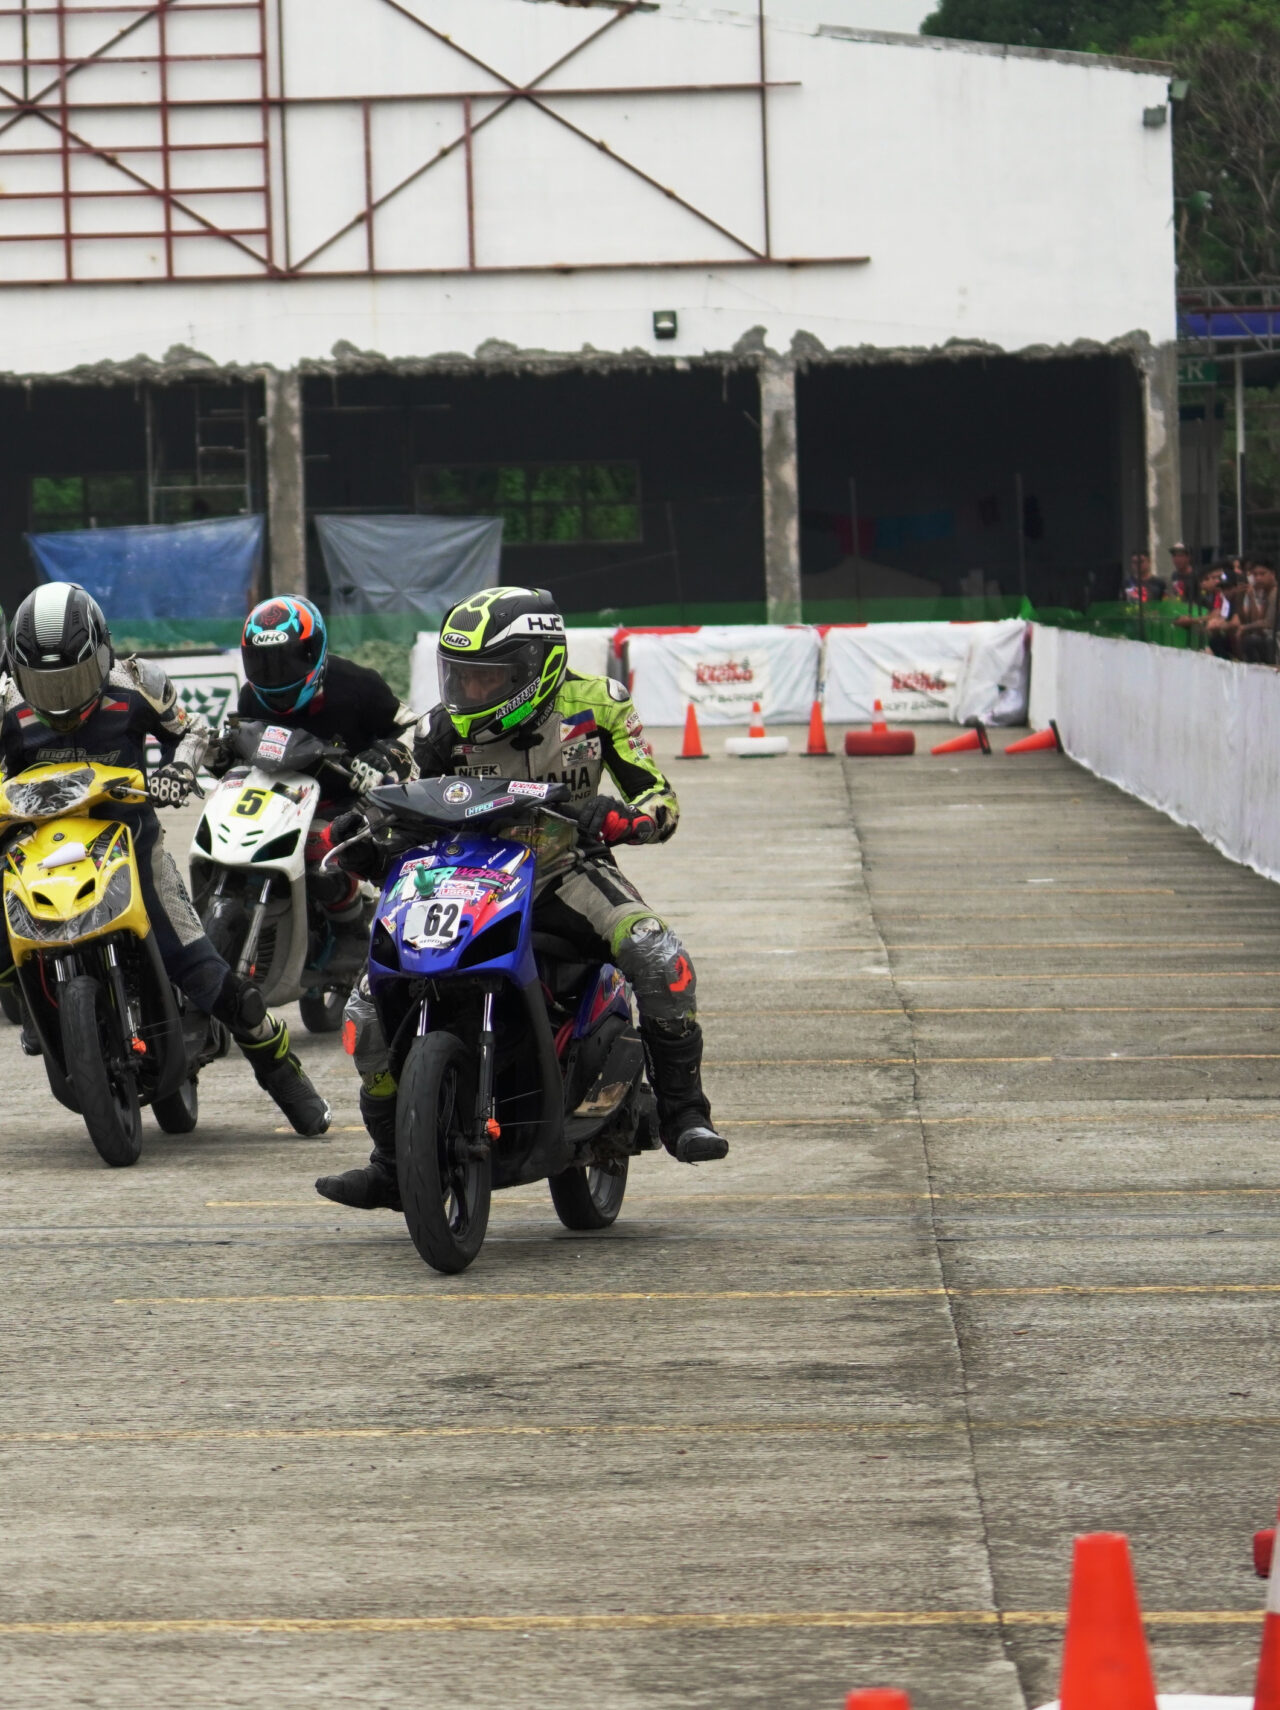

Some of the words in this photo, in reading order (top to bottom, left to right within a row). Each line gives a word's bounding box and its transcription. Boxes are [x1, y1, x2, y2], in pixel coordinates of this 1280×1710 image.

[528, 617, 563, 631] HJC
[446, 634, 468, 646] HJC
[236, 789, 267, 816] 5
[423, 903, 459, 939] 62
